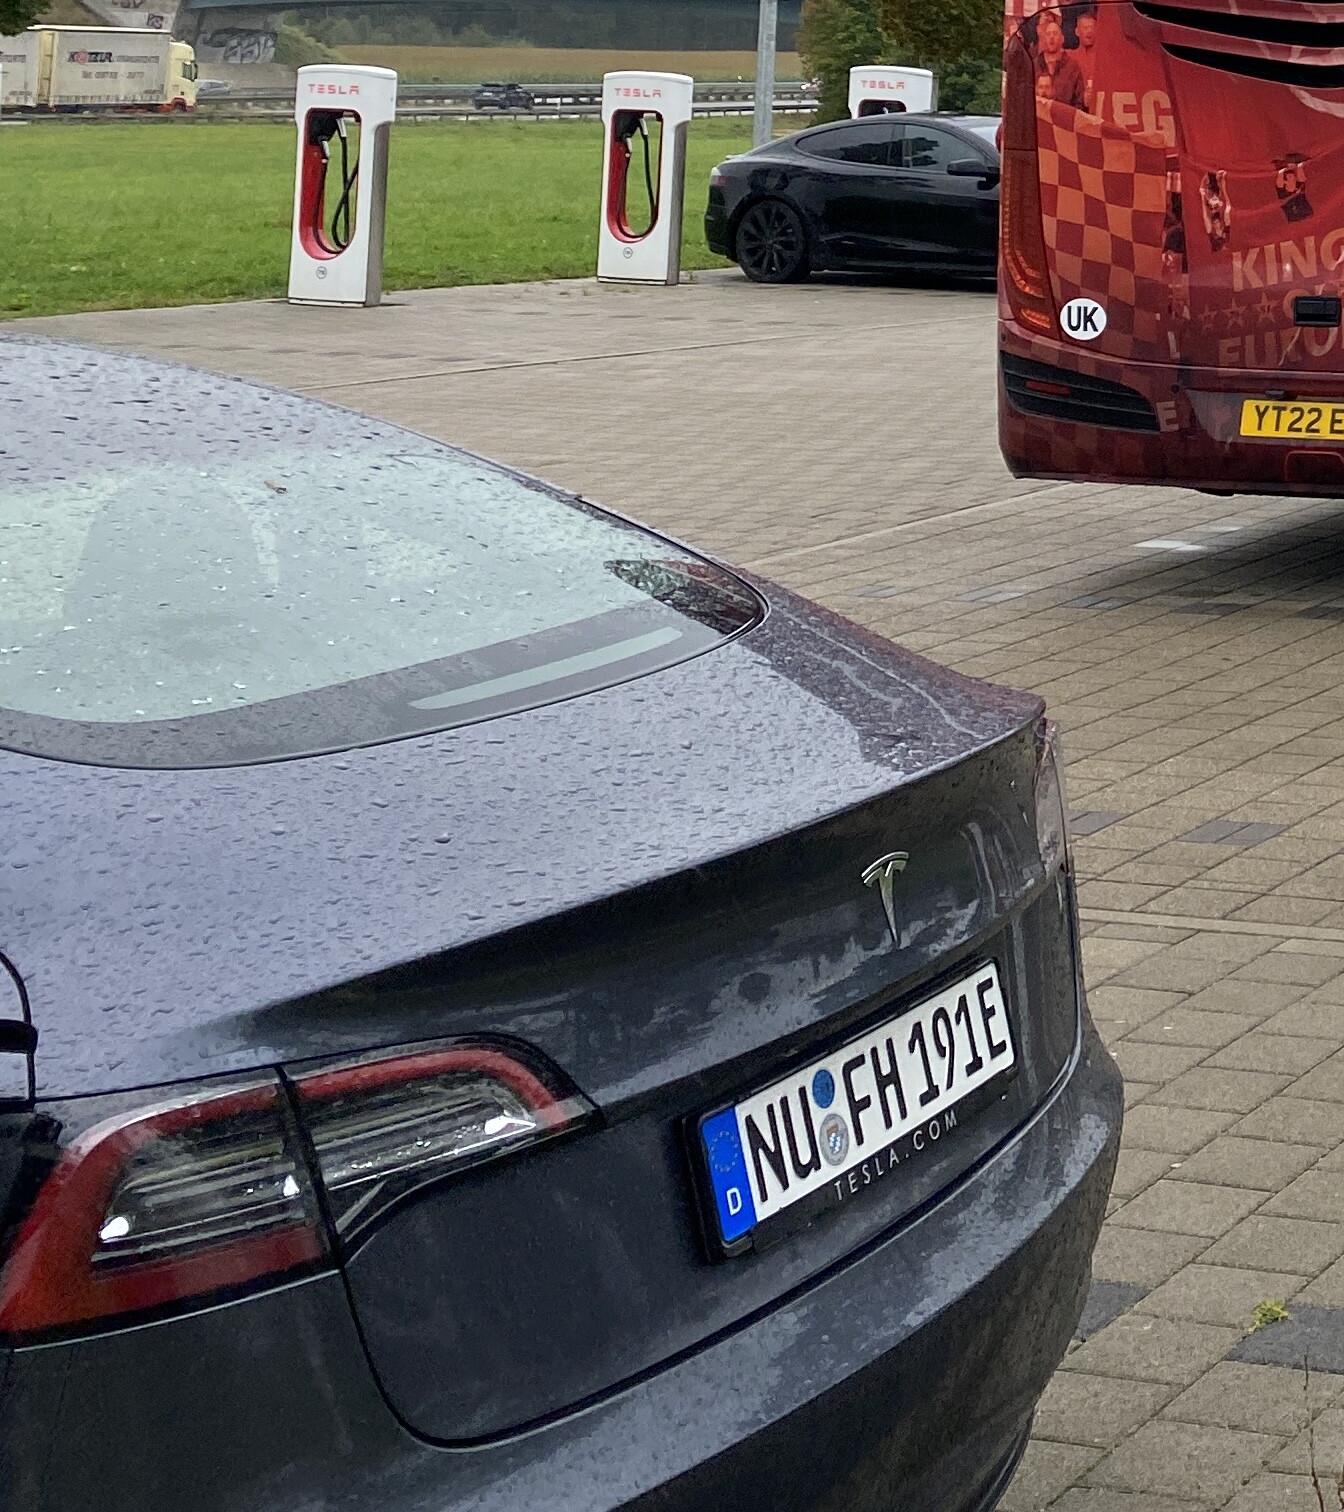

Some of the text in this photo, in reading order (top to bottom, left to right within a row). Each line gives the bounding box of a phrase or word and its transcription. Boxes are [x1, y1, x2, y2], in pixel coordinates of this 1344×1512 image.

[308, 83, 360, 95] TESLA
[614, 87, 662, 98] TESLA
[861, 80, 905, 90] TESLA
[1067, 305, 1099, 333] UK
[1255, 404, 1324, 434] YT22
[744, 977, 1007, 1203] NU FH 191E
[833, 1109, 958, 1201] TESLA.COM
[726, 1186, 743, 1216] D
